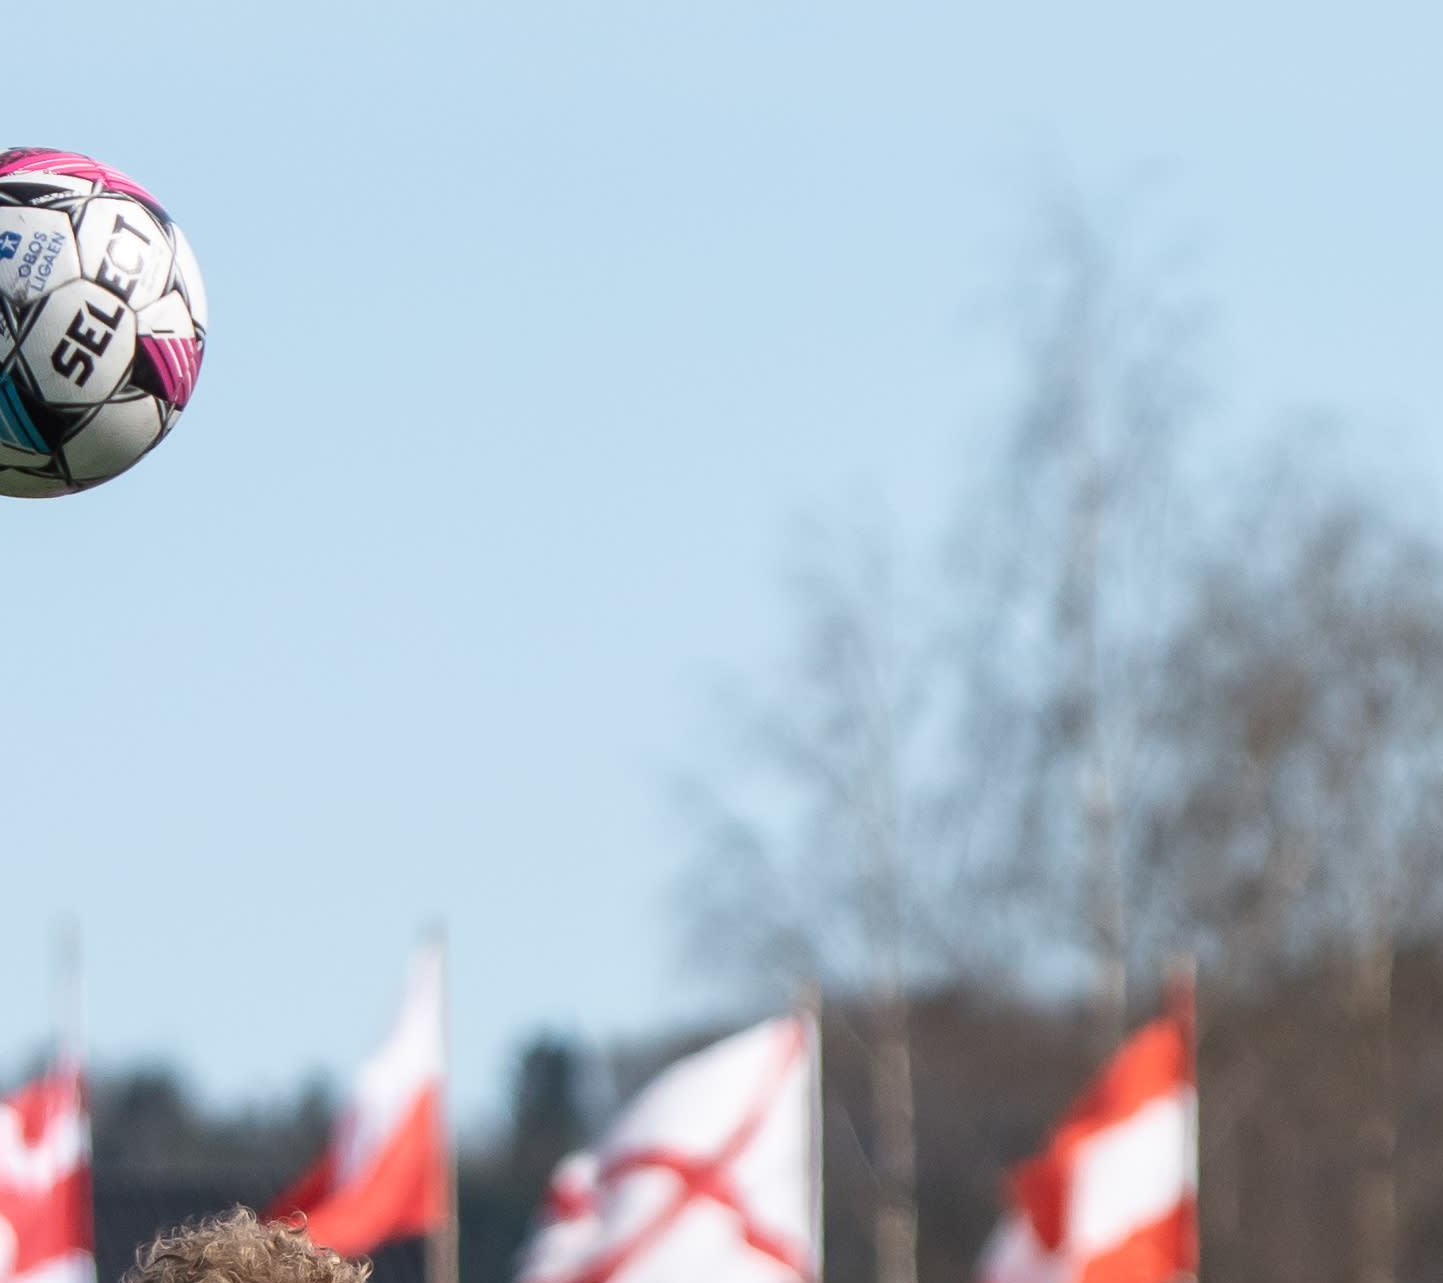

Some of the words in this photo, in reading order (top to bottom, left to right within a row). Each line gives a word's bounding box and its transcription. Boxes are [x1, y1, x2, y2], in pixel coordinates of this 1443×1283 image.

[18, 231, 48, 278] OBOS
[30, 232, 66, 292] LIGAEN
[50, 213, 153, 388] SELECT
